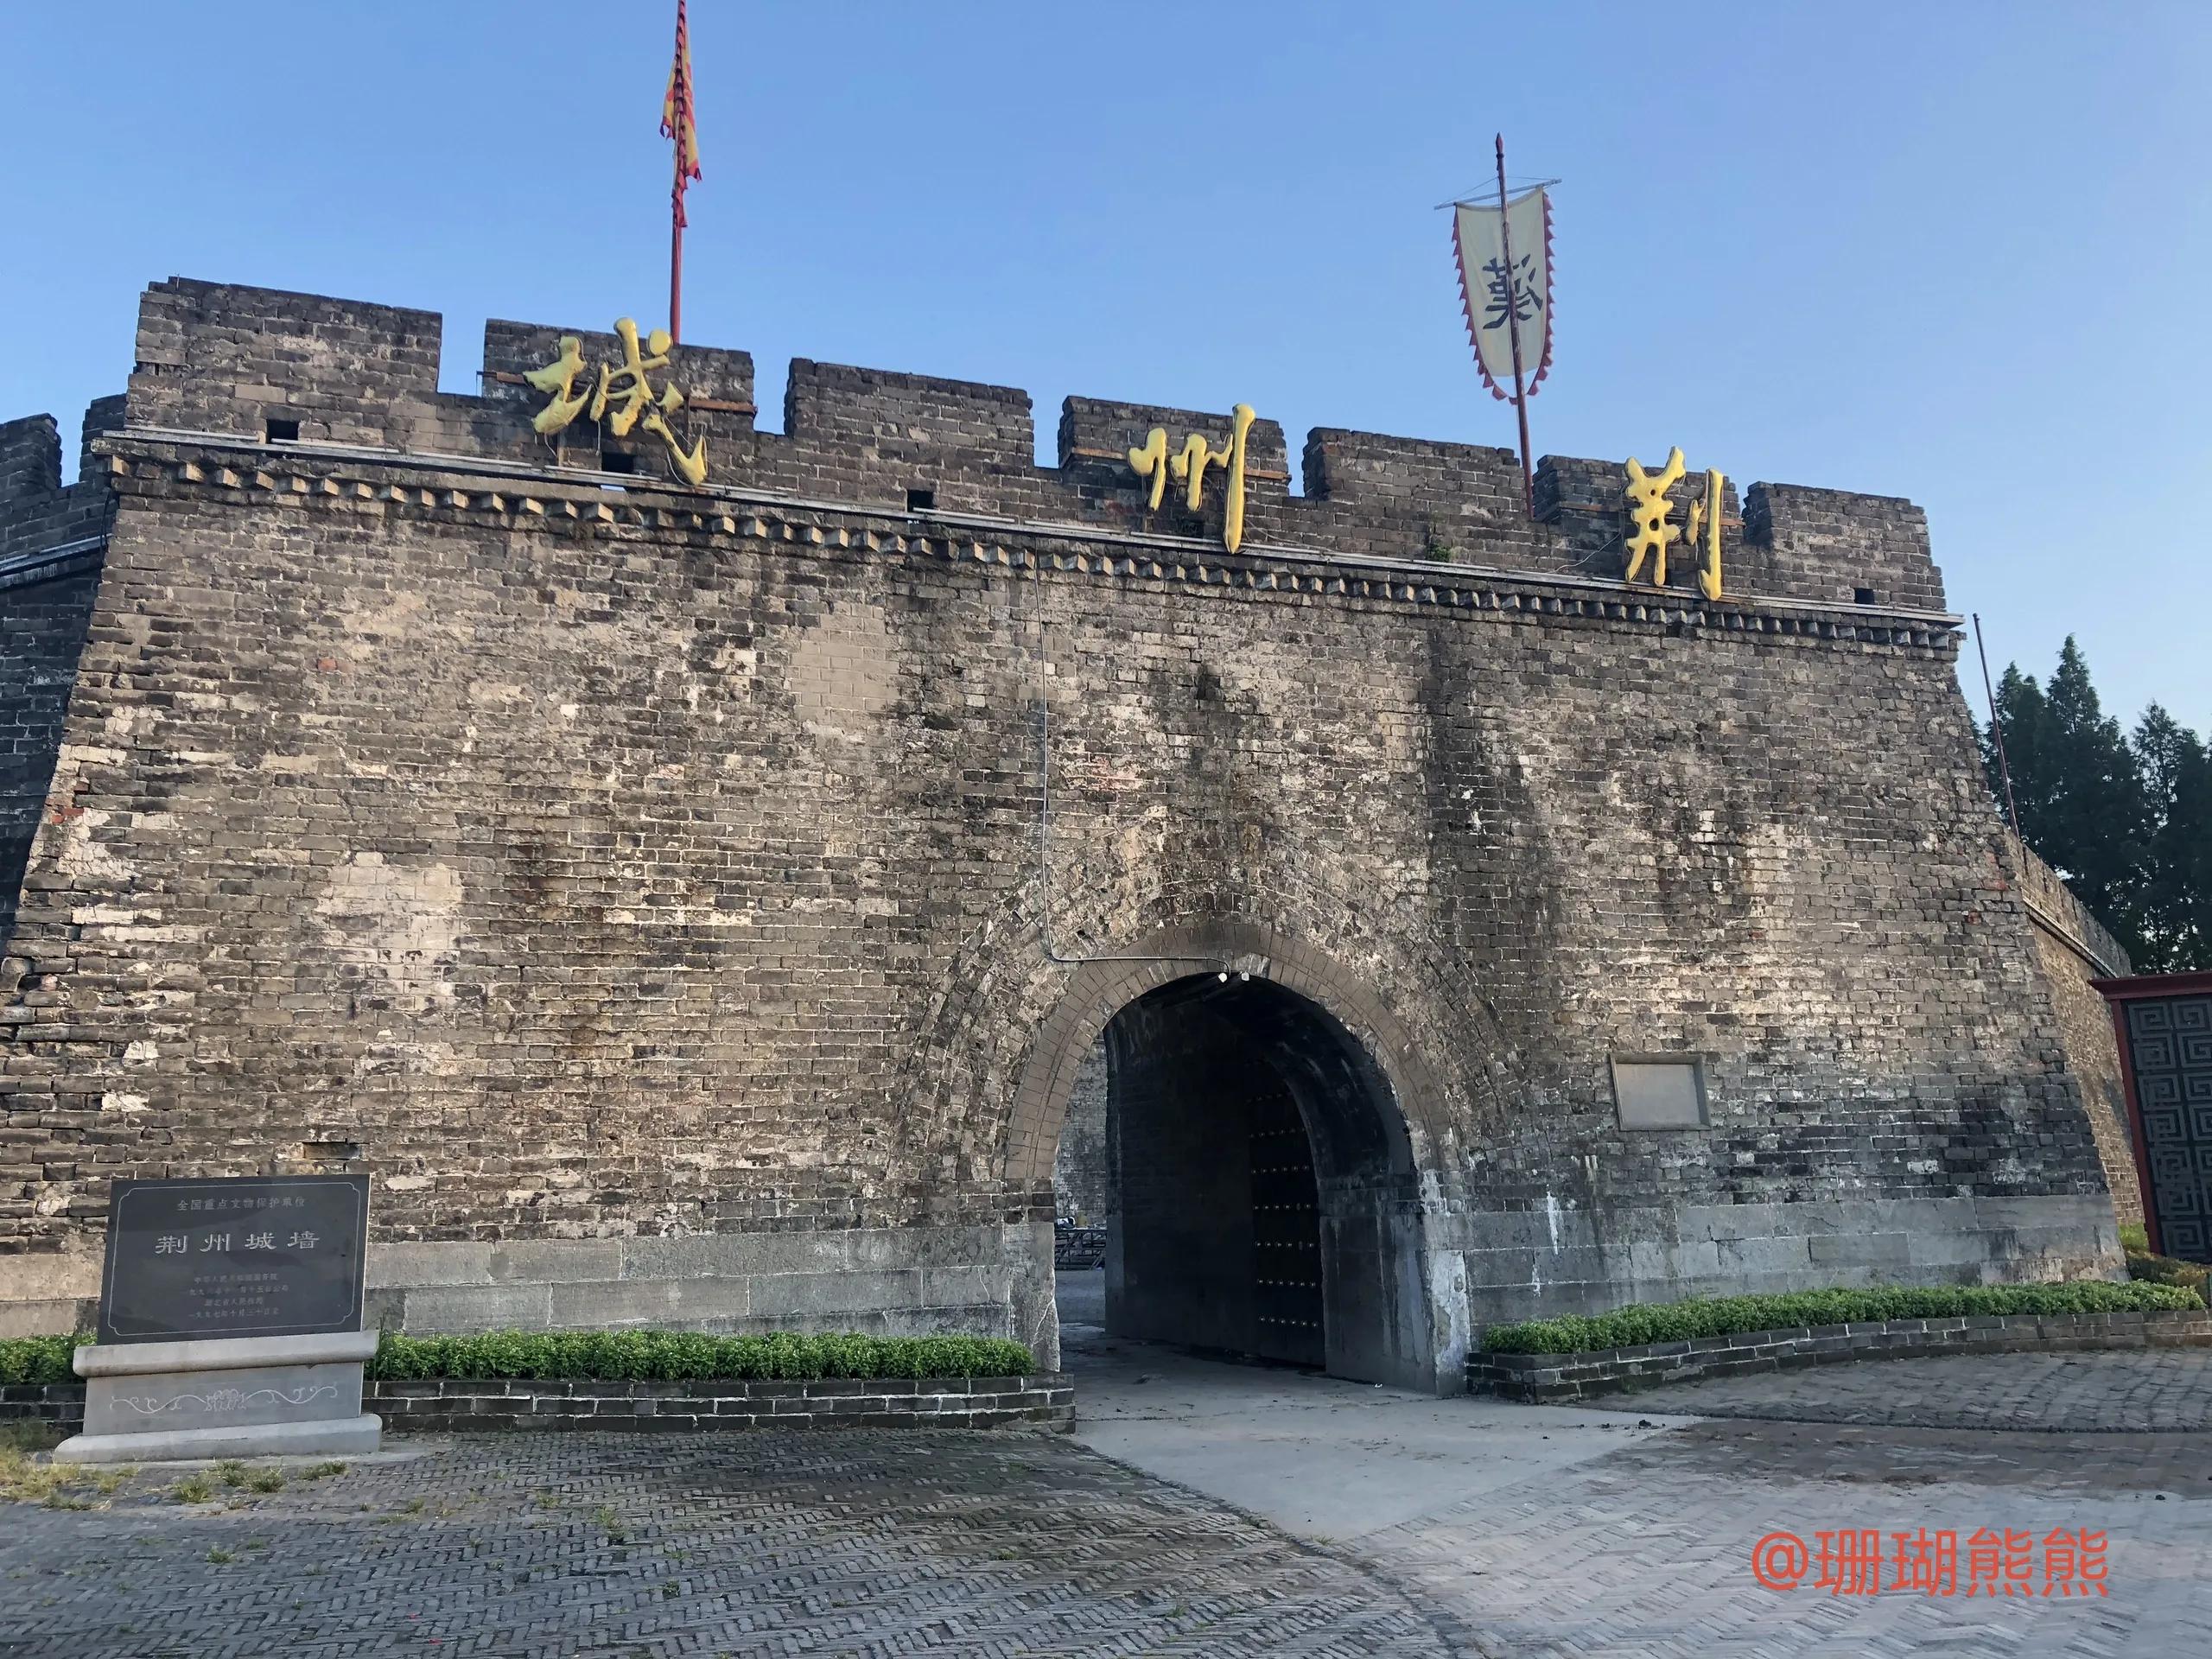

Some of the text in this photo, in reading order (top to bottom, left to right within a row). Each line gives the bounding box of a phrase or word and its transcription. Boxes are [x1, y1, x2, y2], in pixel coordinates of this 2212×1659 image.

[177, 1196, 305, 1211] 全国重点文物保护单位
[155, 1230, 320, 1255] 荆州城墙
